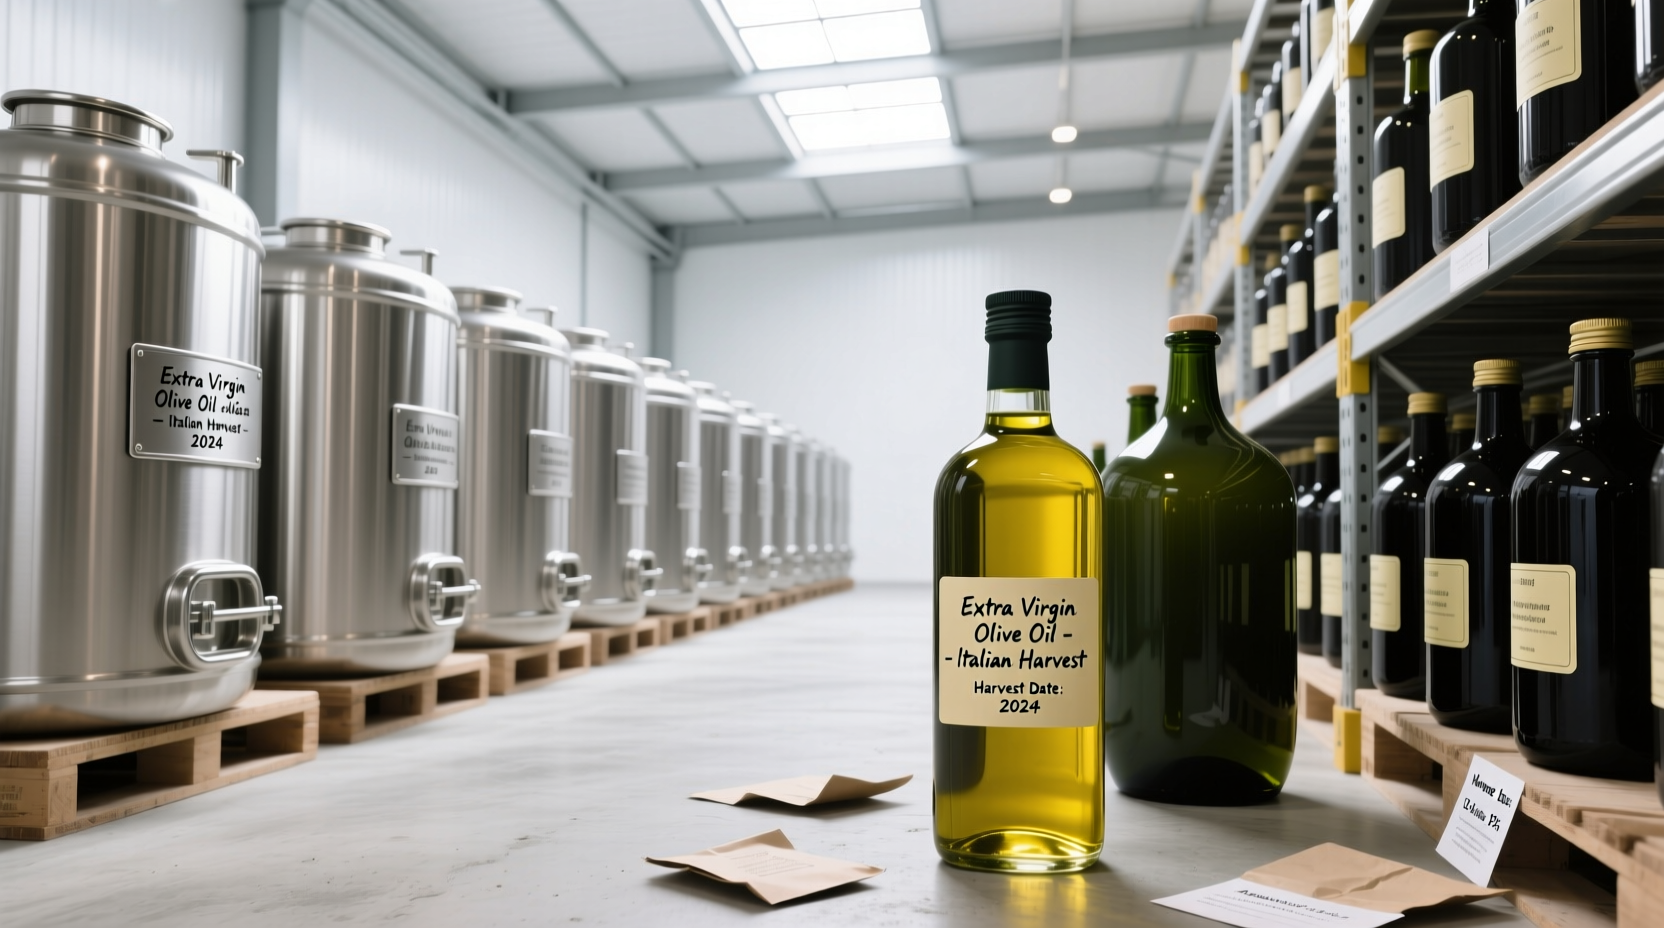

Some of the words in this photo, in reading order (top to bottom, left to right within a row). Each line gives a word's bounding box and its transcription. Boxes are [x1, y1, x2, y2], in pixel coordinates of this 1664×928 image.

[160, 366, 203, 388] Extra
[208, 372, 245, 399] Virgin
[155, 389, 192, 410] Olive
[198, 394, 217, 413] Oil
[190, 433, 223, 450] 2024
[961, 595, 1013, 617] Extra
[1021, 596, 1077, 624] Virgin
[974, 622, 1022, 643] Olive
[1029, 622, 1057, 643] Oil
[957, 647, 1012, 668] Italian
[1019, 648, 1088, 670] Harvest
[974, 680, 1025, 695] Harvest
[1029, 681, 1064, 695] Date:
[999, 699, 1041, 714] 2024
